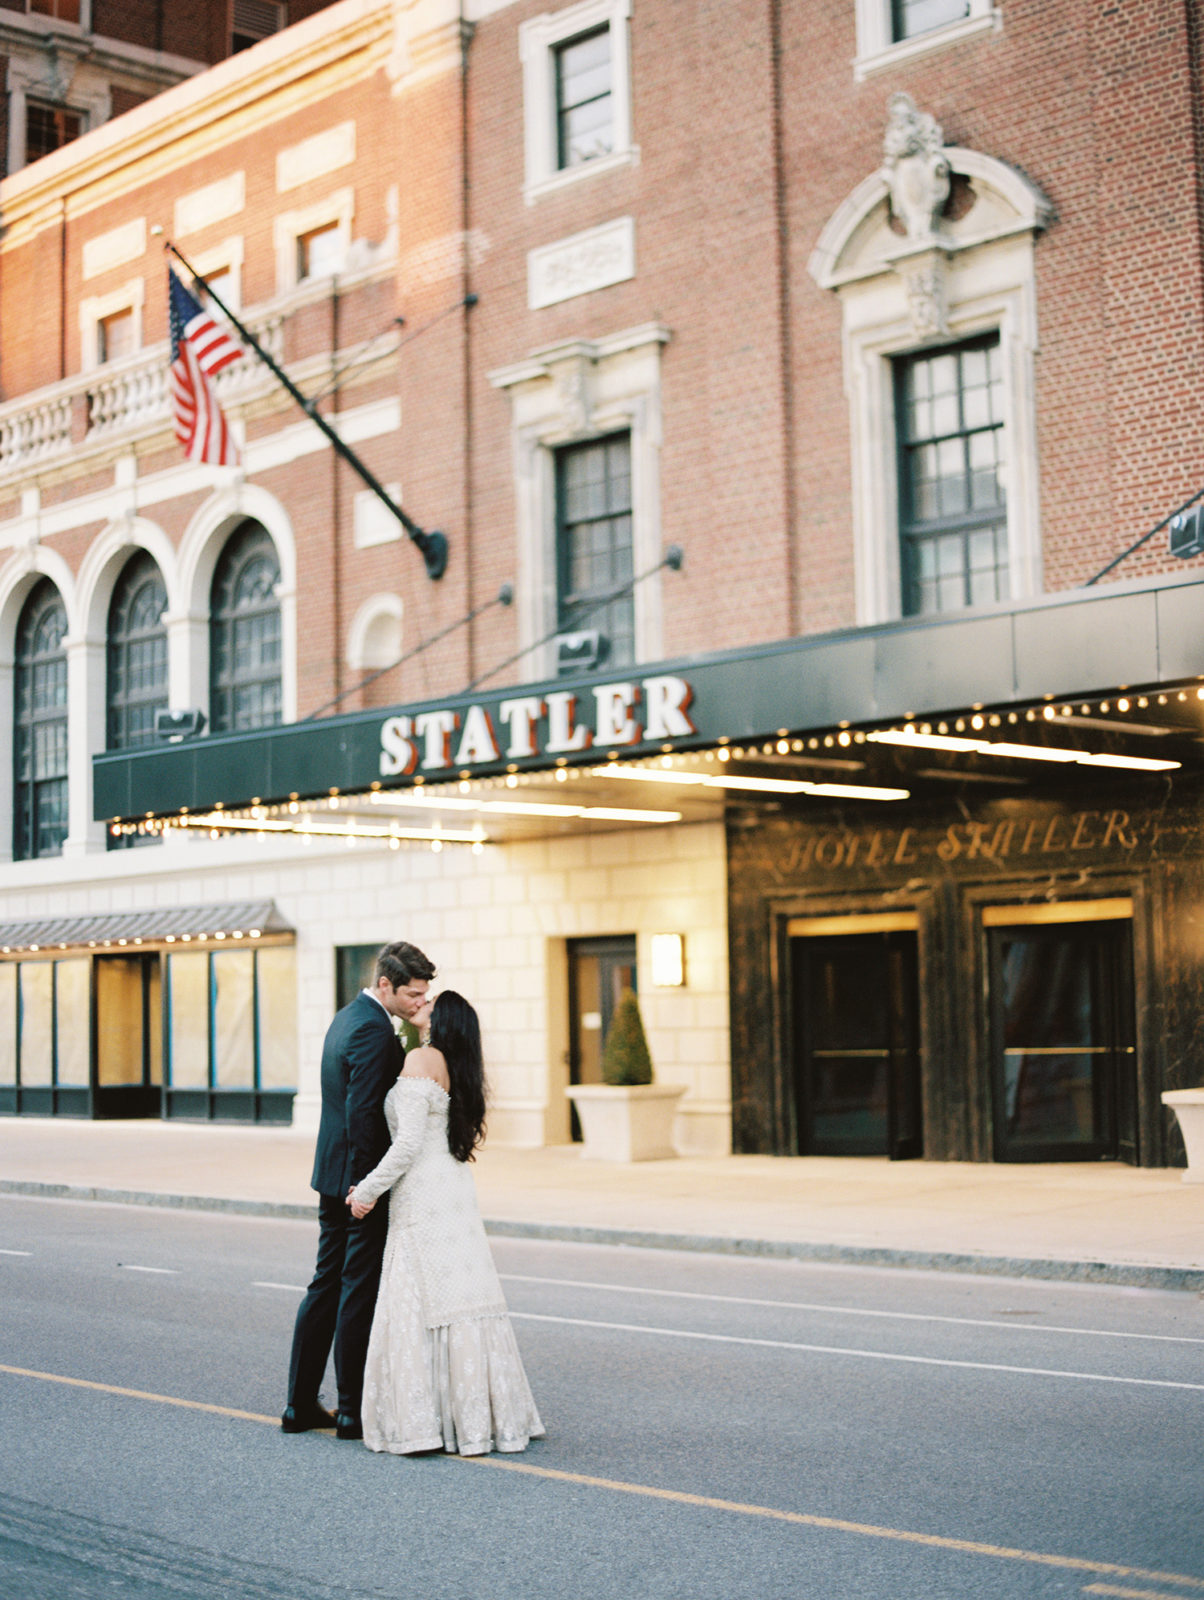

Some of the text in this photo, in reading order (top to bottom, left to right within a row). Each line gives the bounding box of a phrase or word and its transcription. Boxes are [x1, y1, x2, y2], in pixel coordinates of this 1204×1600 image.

[379, 675, 697, 776] STATLER
[781, 810, 1138, 870] HOTEL STATLER
